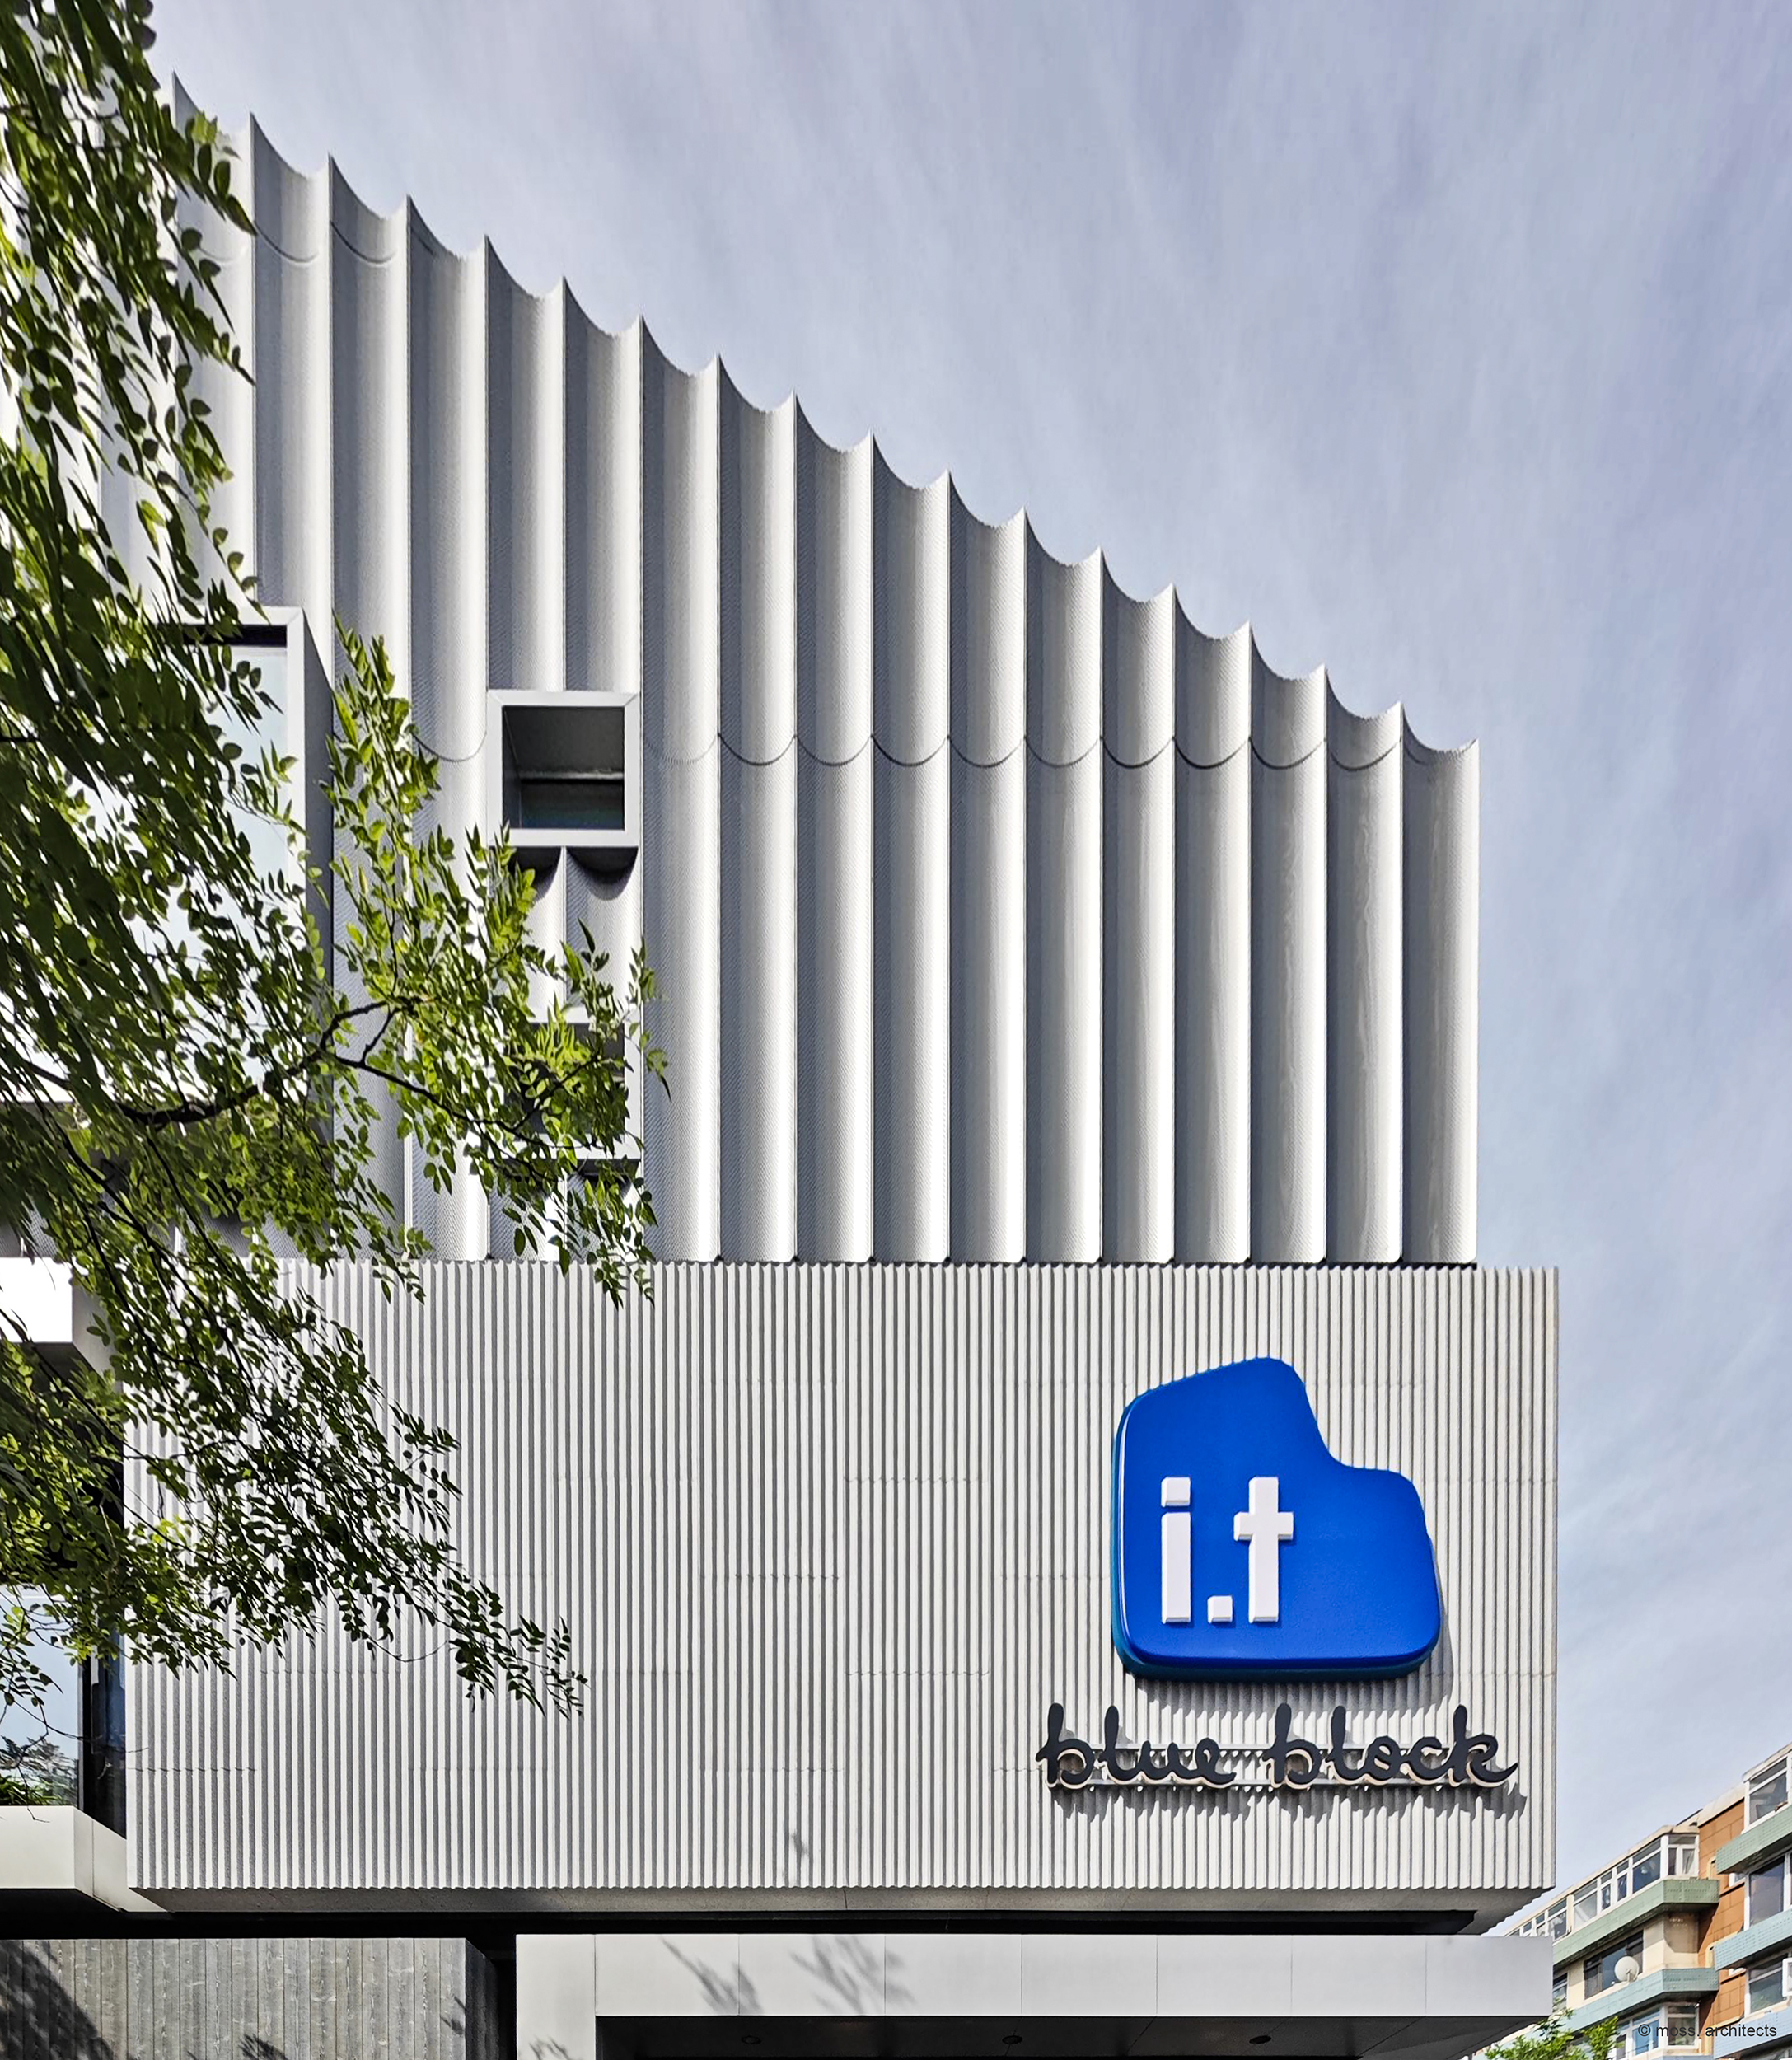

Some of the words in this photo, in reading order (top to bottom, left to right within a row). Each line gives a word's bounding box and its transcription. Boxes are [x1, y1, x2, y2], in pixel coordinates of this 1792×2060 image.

[1161, 1477, 1294, 1624] i.t
[1036, 1702, 1236, 1786] blue
[1262, 1702, 1518, 1787] block
